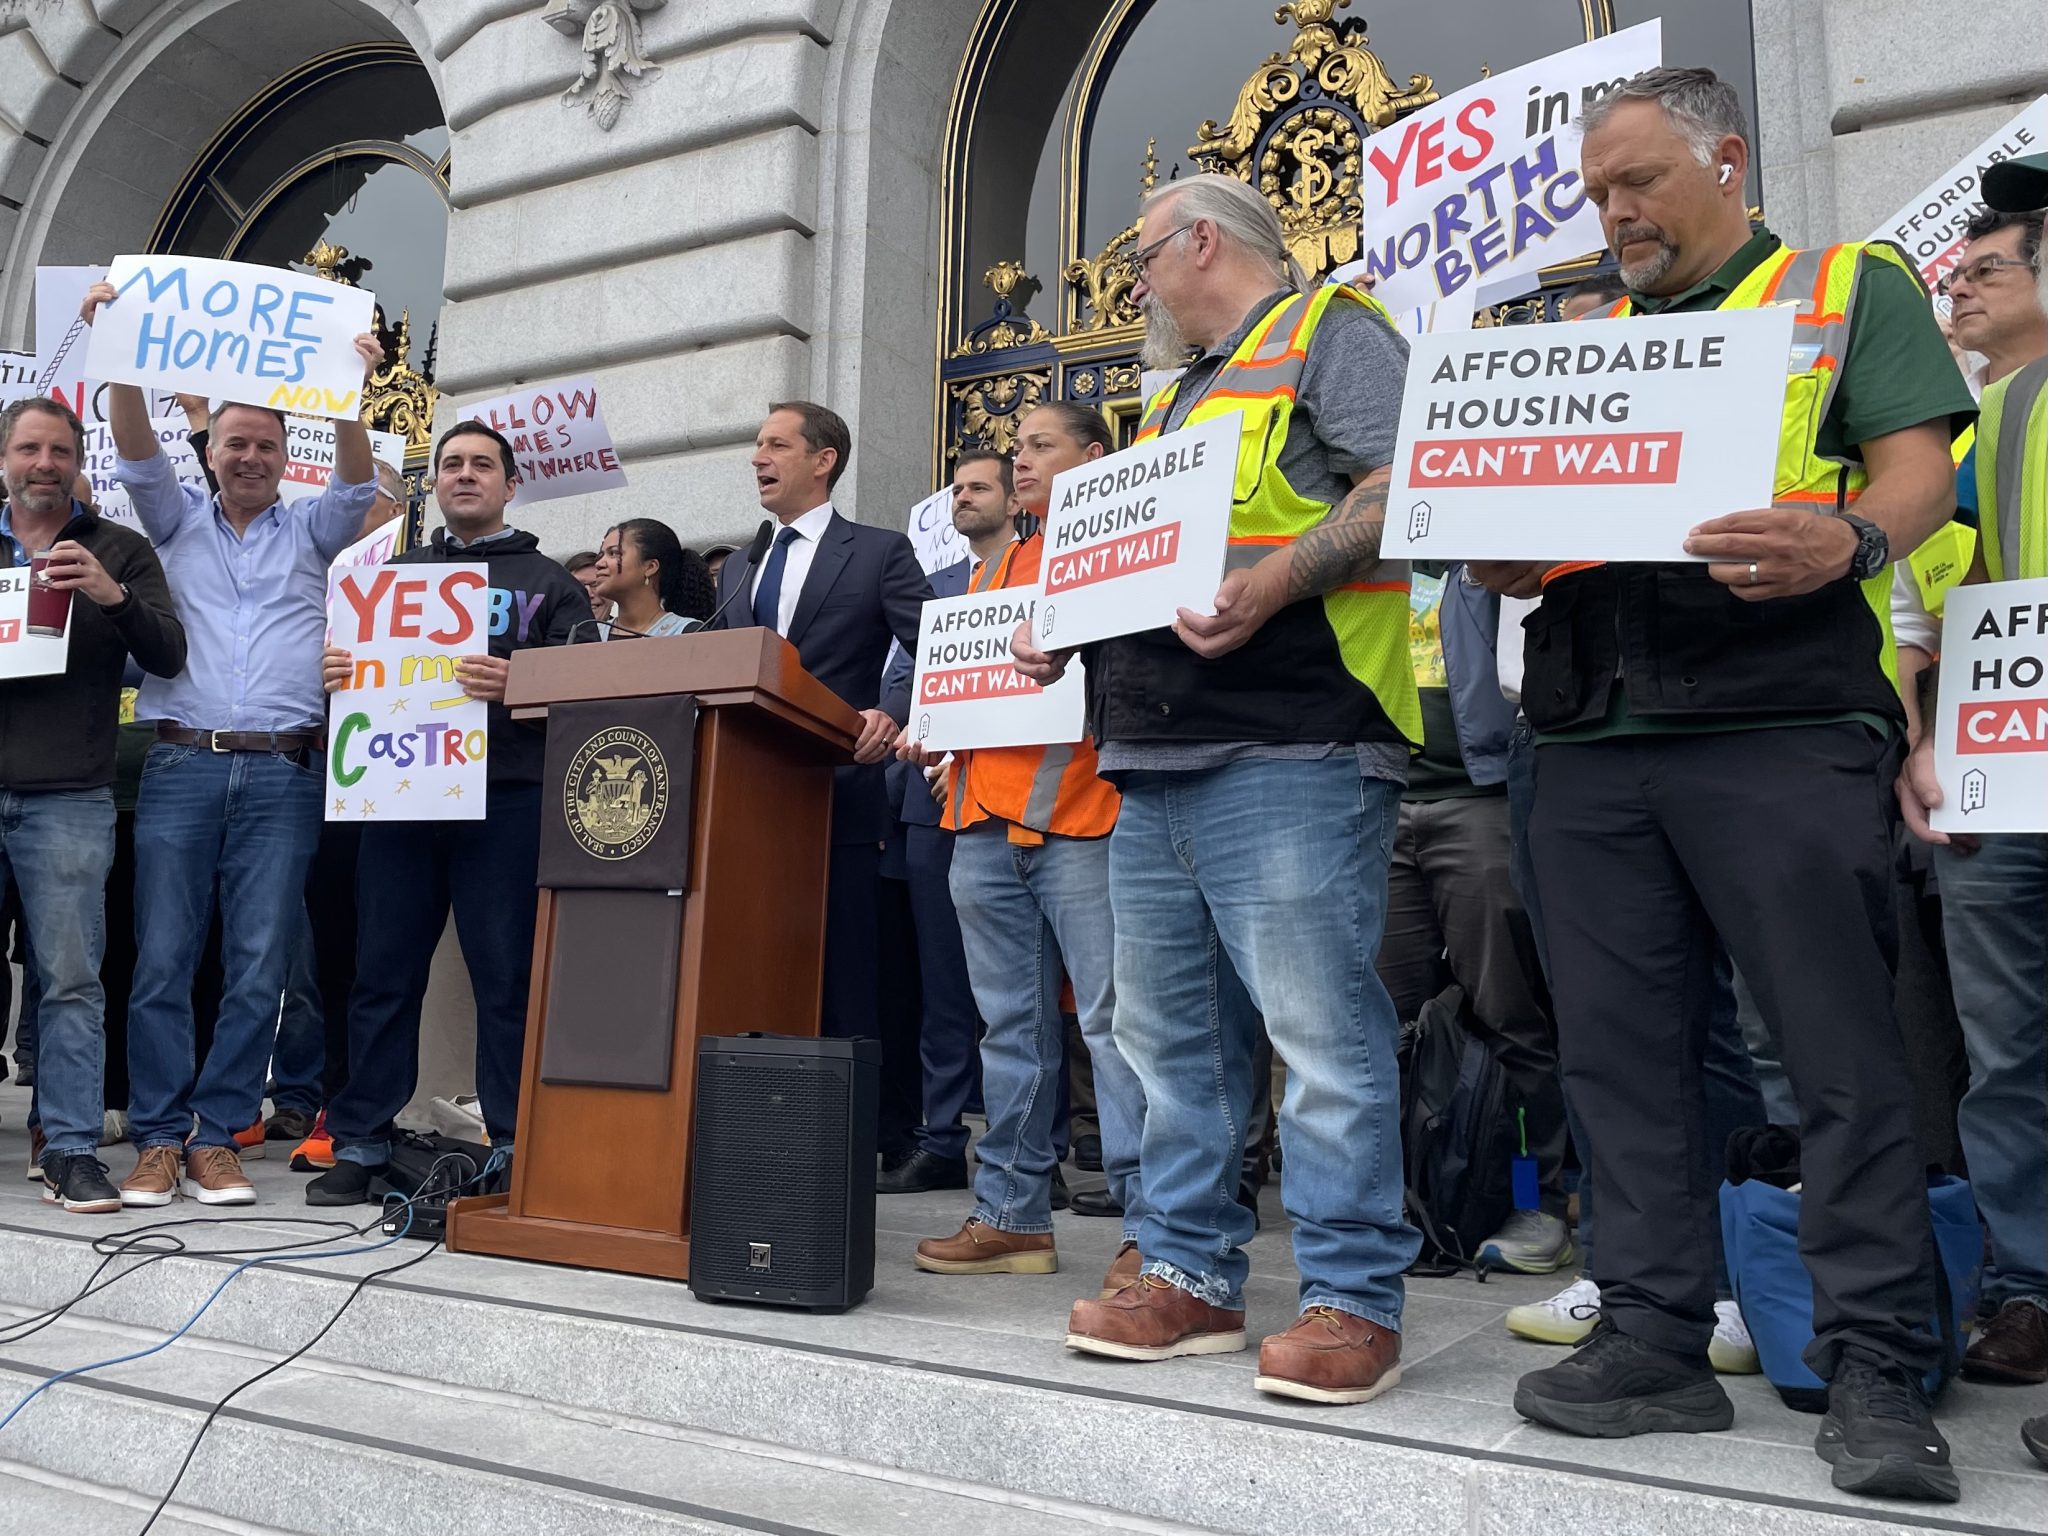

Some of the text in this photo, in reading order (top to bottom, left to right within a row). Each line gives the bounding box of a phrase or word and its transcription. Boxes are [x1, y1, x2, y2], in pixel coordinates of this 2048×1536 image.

[1368, 98, 1496, 208] YES
[1526, 86, 1569, 139] in
[1894, 127, 2036, 243] FFORDABLE
[1367, 136, 1559, 281] NORTH
[1432, 168, 1588, 298] BEAC
[105, 266, 335, 344] MORE
[135, 312, 318, 383] HOMES
[1430, 335, 1726, 384] AFFORDABLE
[268, 383, 357, 412] NOW
[1426, 392, 1631, 430] HOUSING
[84, 427, 113, 451] Th
[291, 445, 333, 464] USIN
[513, 424, 573, 454] MES
[1418, 441, 1669, 478] CAN'T WAIT
[284, 465, 311, 480] N'T
[1060, 441, 1206, 512] AFFORDABLE
[918, 490, 952, 532] CIT
[1056, 496, 1157, 549] HOUSING
[1050, 530, 1175, 586] CAN'T WAIT
[0, 578, 26, 593] BL
[338, 570, 488, 645] YES
[488, 587, 545, 642] BY
[1971, 603, 2048, 640] AFF
[928, 636, 1008, 666] HOUSIN
[924, 671, 983, 698] CAN'T
[1972, 656, 2043, 691] HO
[567, 731, 665, 854] SEAL OF THE CITY AND COUNTY OF SAN FRANCISCO
[752, 1248, 768, 1262] EV
